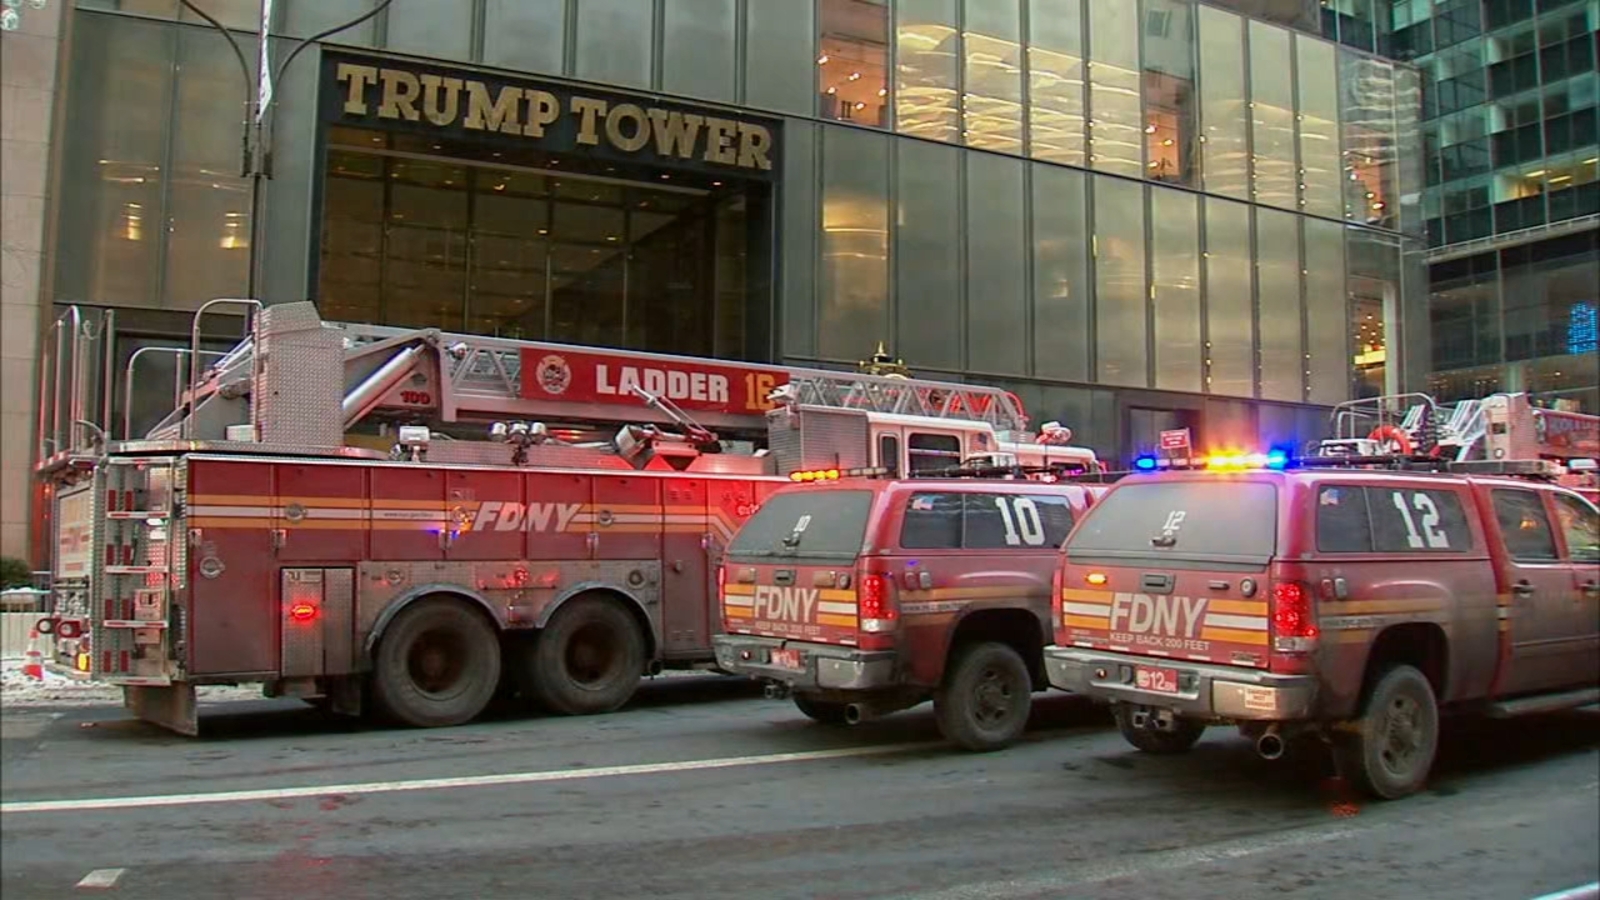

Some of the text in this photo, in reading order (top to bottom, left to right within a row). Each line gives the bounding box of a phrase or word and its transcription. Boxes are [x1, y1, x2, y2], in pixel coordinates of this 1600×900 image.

[337, 62, 772, 171] TRUMP TOWER
[596, 364, 729, 402] LADDER
[473, 501, 583, 533] FDNY
[793, 514, 811, 532] 10
[995, 497, 1046, 546] 10
[1163, 510, 1187, 531] 12
[1393, 492, 1450, 548] 12
[755, 584, 819, 623] FDNY
[1110, 591, 1208, 638] FDNY
[1110, 632, 1134, 643] KEEP
[1136, 634, 1163, 647] BACK
[1165, 637, 1182, 649] 200
[1184, 640, 1211, 651] FEET
[1150, 671, 1165, 690] 12
